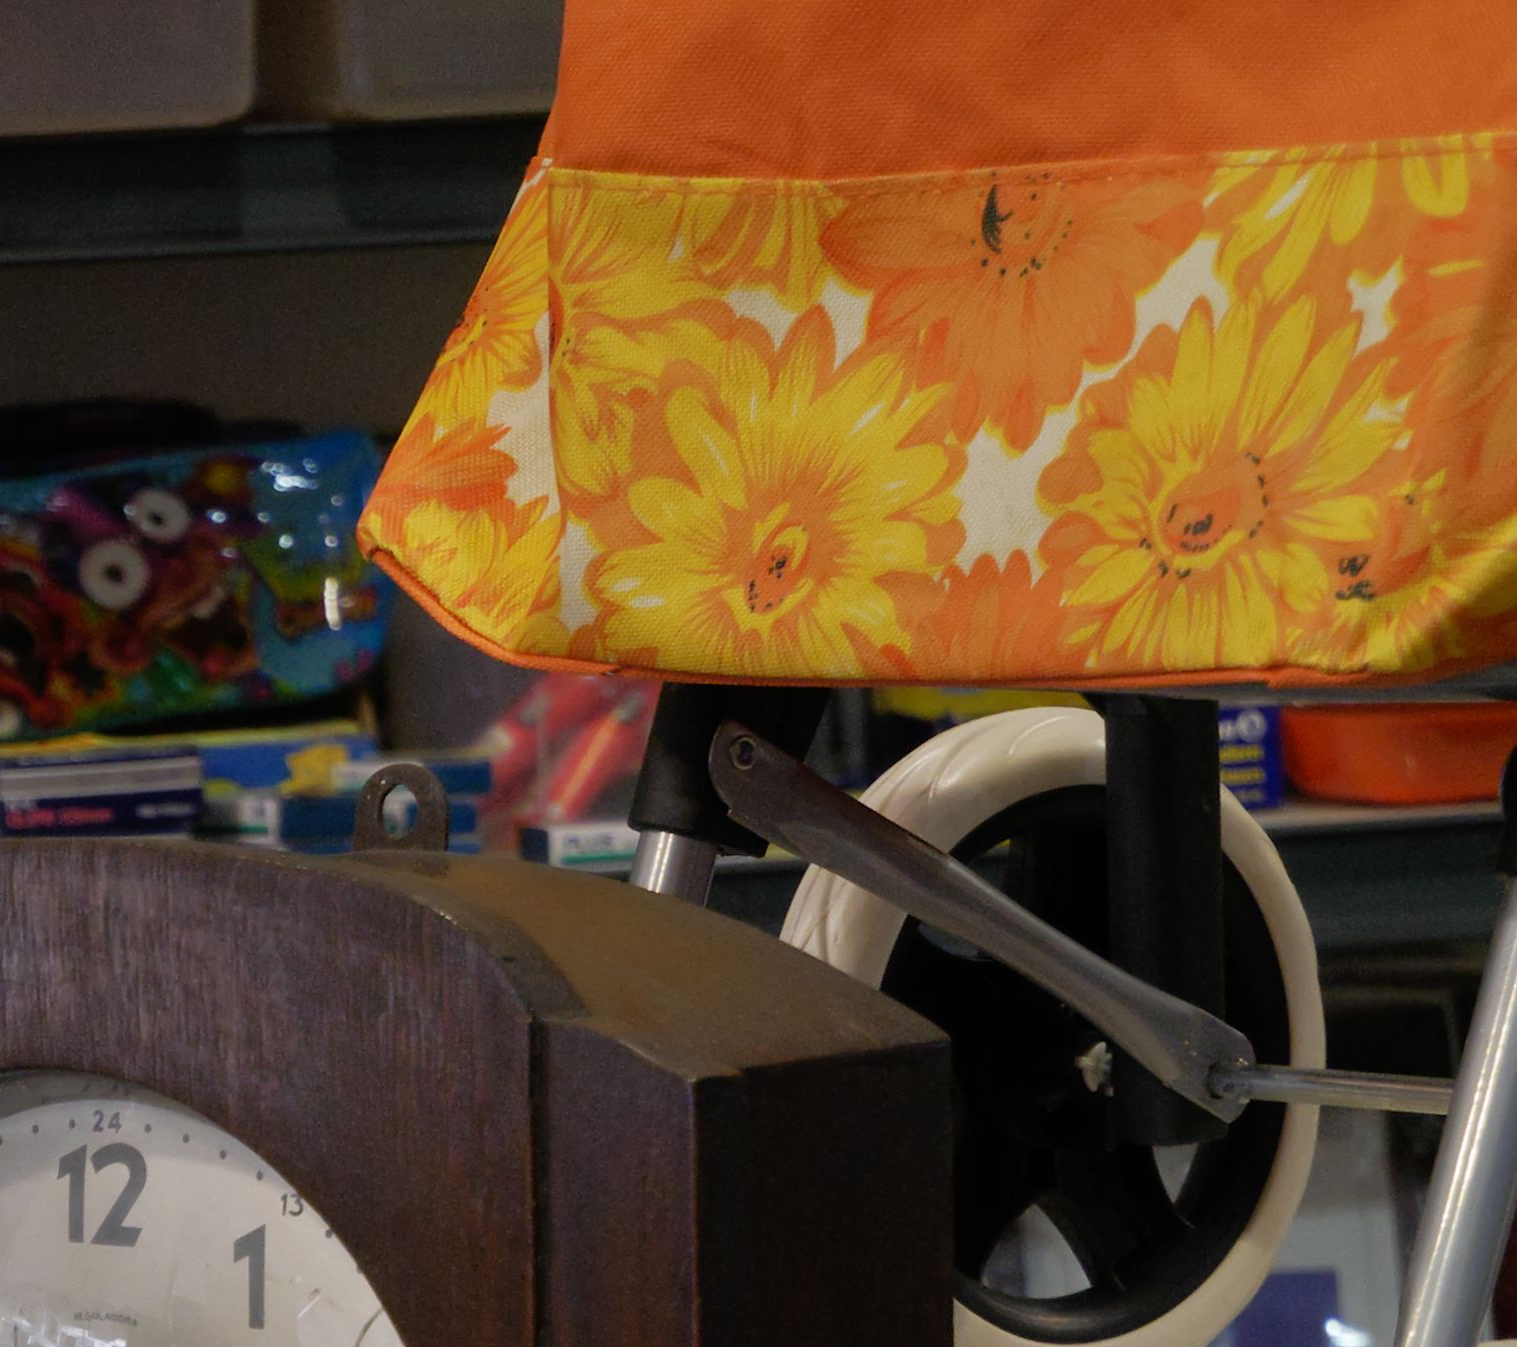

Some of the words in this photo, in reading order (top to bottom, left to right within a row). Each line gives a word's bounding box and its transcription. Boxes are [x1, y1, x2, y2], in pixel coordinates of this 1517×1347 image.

[92, 1110, 122, 1133] 24
[58, 1142, 148, 1247] 12
[280, 1194, 304, 1217] 13
[233, 1224, 267, 1330] 1
